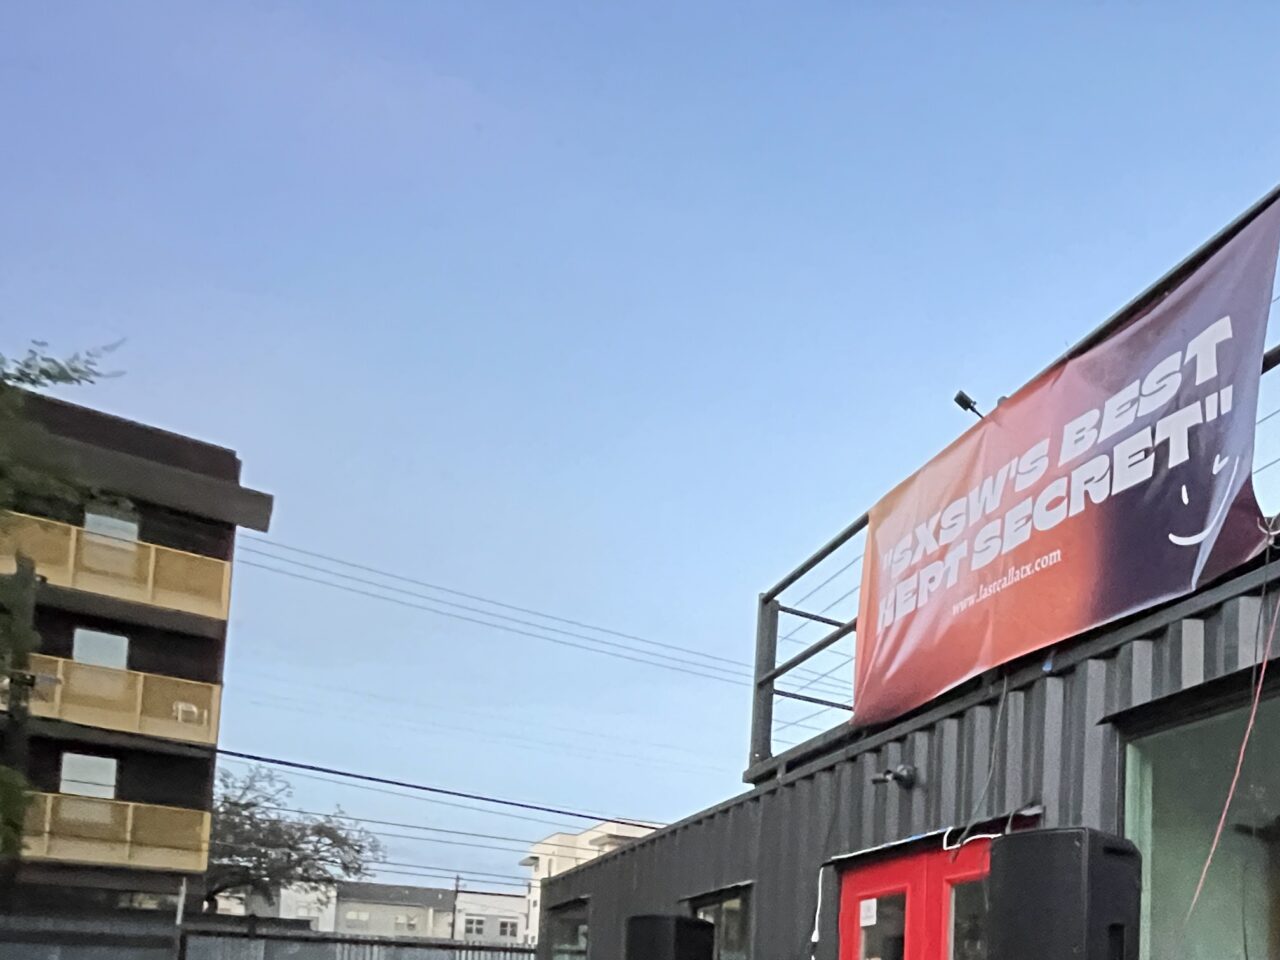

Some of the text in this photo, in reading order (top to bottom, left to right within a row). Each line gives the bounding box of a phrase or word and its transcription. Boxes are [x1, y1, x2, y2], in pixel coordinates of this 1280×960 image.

[1058, 315, 1233, 468] BEST
[971, 384, 1233, 572] SECRET"
[952, 548, 1062, 616] www.lastcallatx.com
